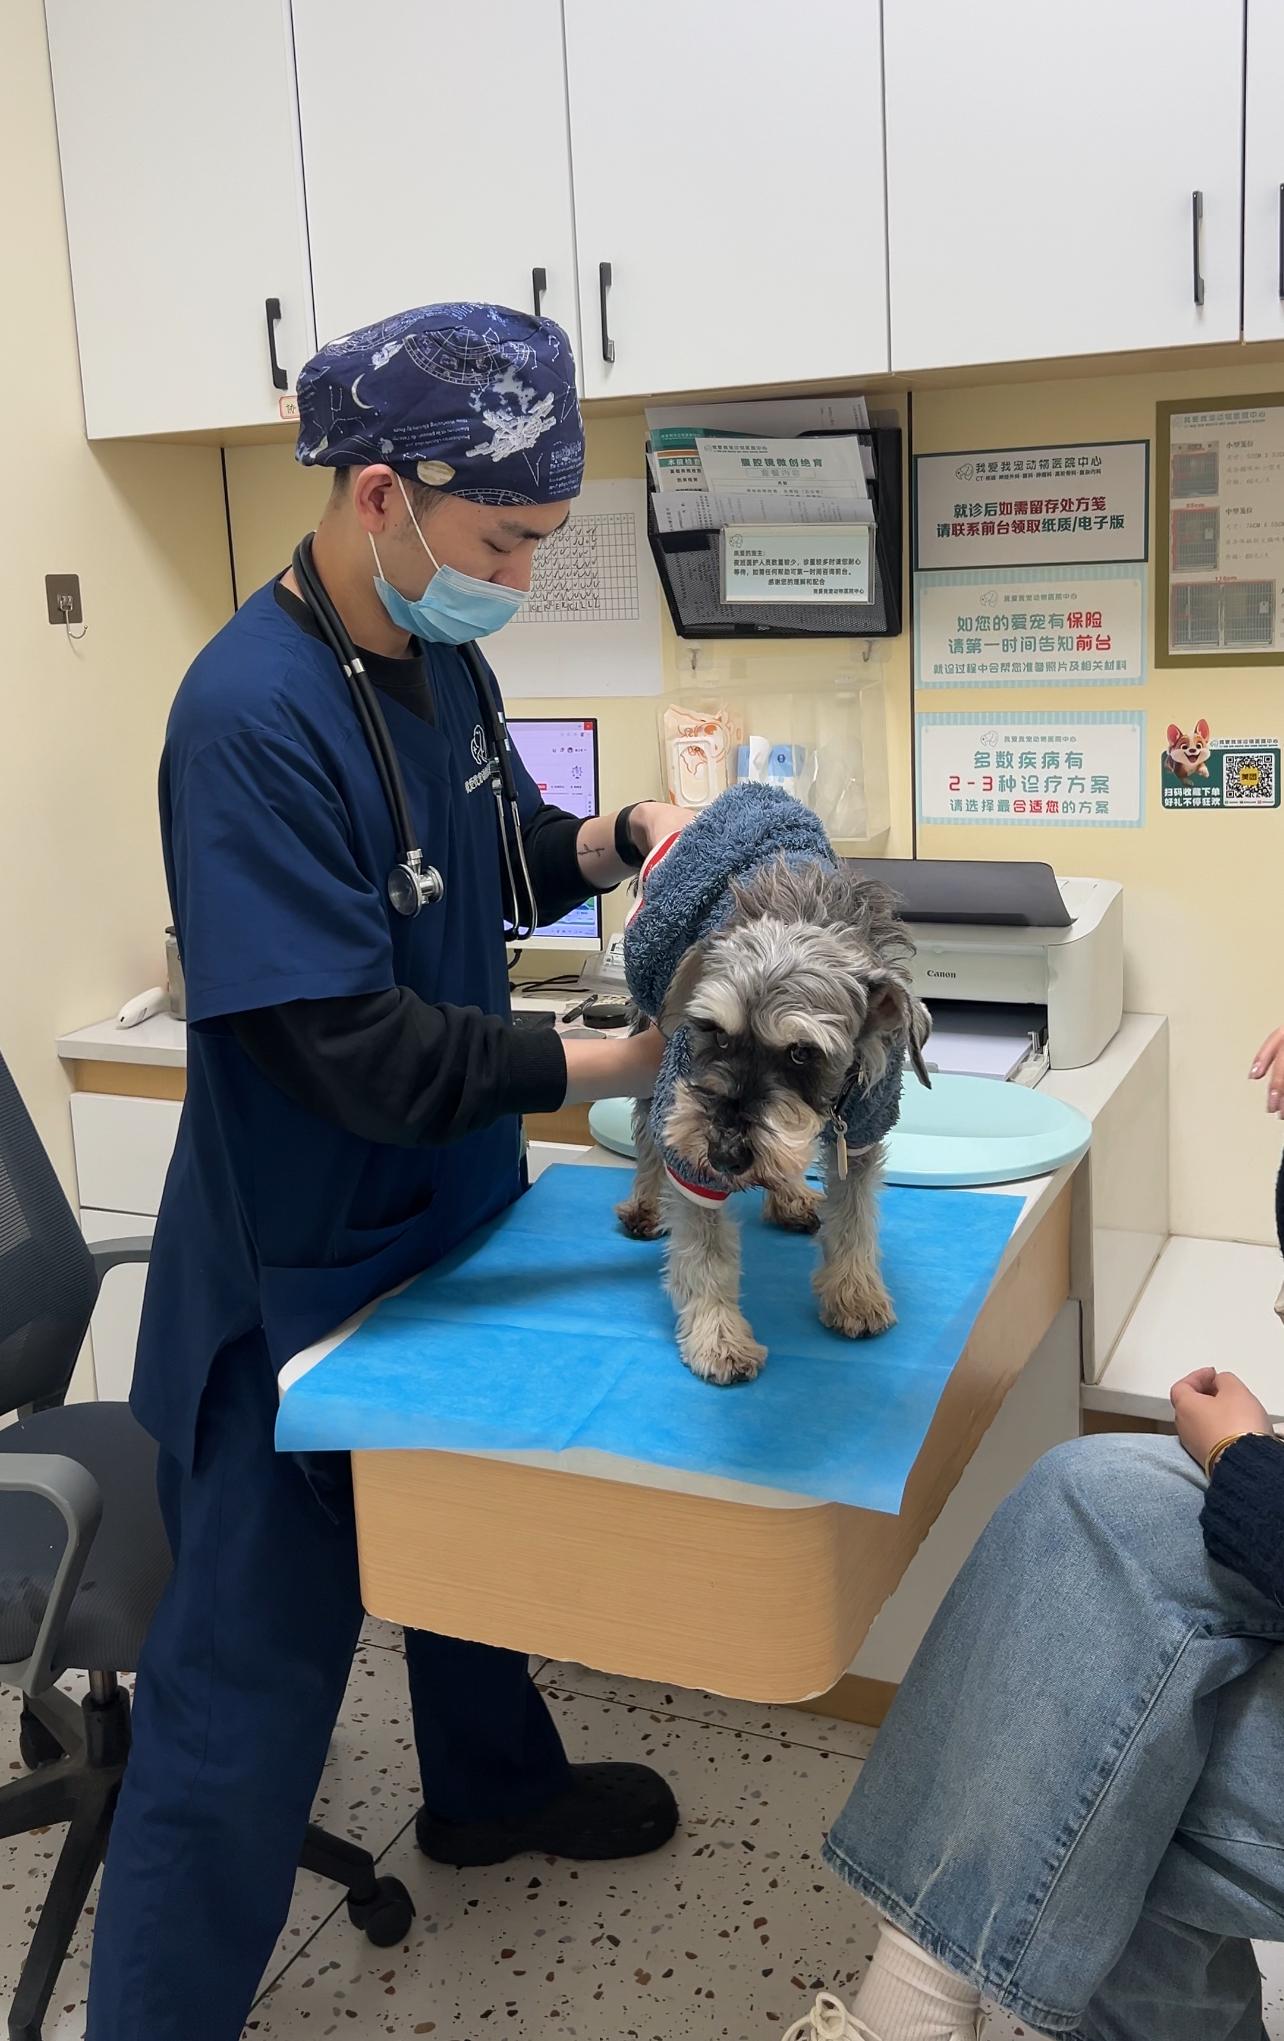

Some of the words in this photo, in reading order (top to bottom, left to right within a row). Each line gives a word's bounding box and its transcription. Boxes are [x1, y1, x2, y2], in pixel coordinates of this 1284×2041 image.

[741, 458, 823, 467] 腹腔镜微创绝育
[975, 456, 1102, 473] 我爱我宠动物医院中心
[953, 496, 1106, 519] 就诊后如需留存处方笺
[936, 514, 1125, 538] 请联系前台领取纸质/电子版
[957, 611, 1103, 633] 如您的爱宠有保险
[948, 634, 1112, 655] 请第一时间告知前台
[933, 660, 1127, 675] 就诊过程中会帮您准备照片及相关材料
[974, 750, 1084, 770] 多数疾病有
[949, 799, 1110, 815] 请选择最合适您的方案
[926, 969, 957, 979] Canon
